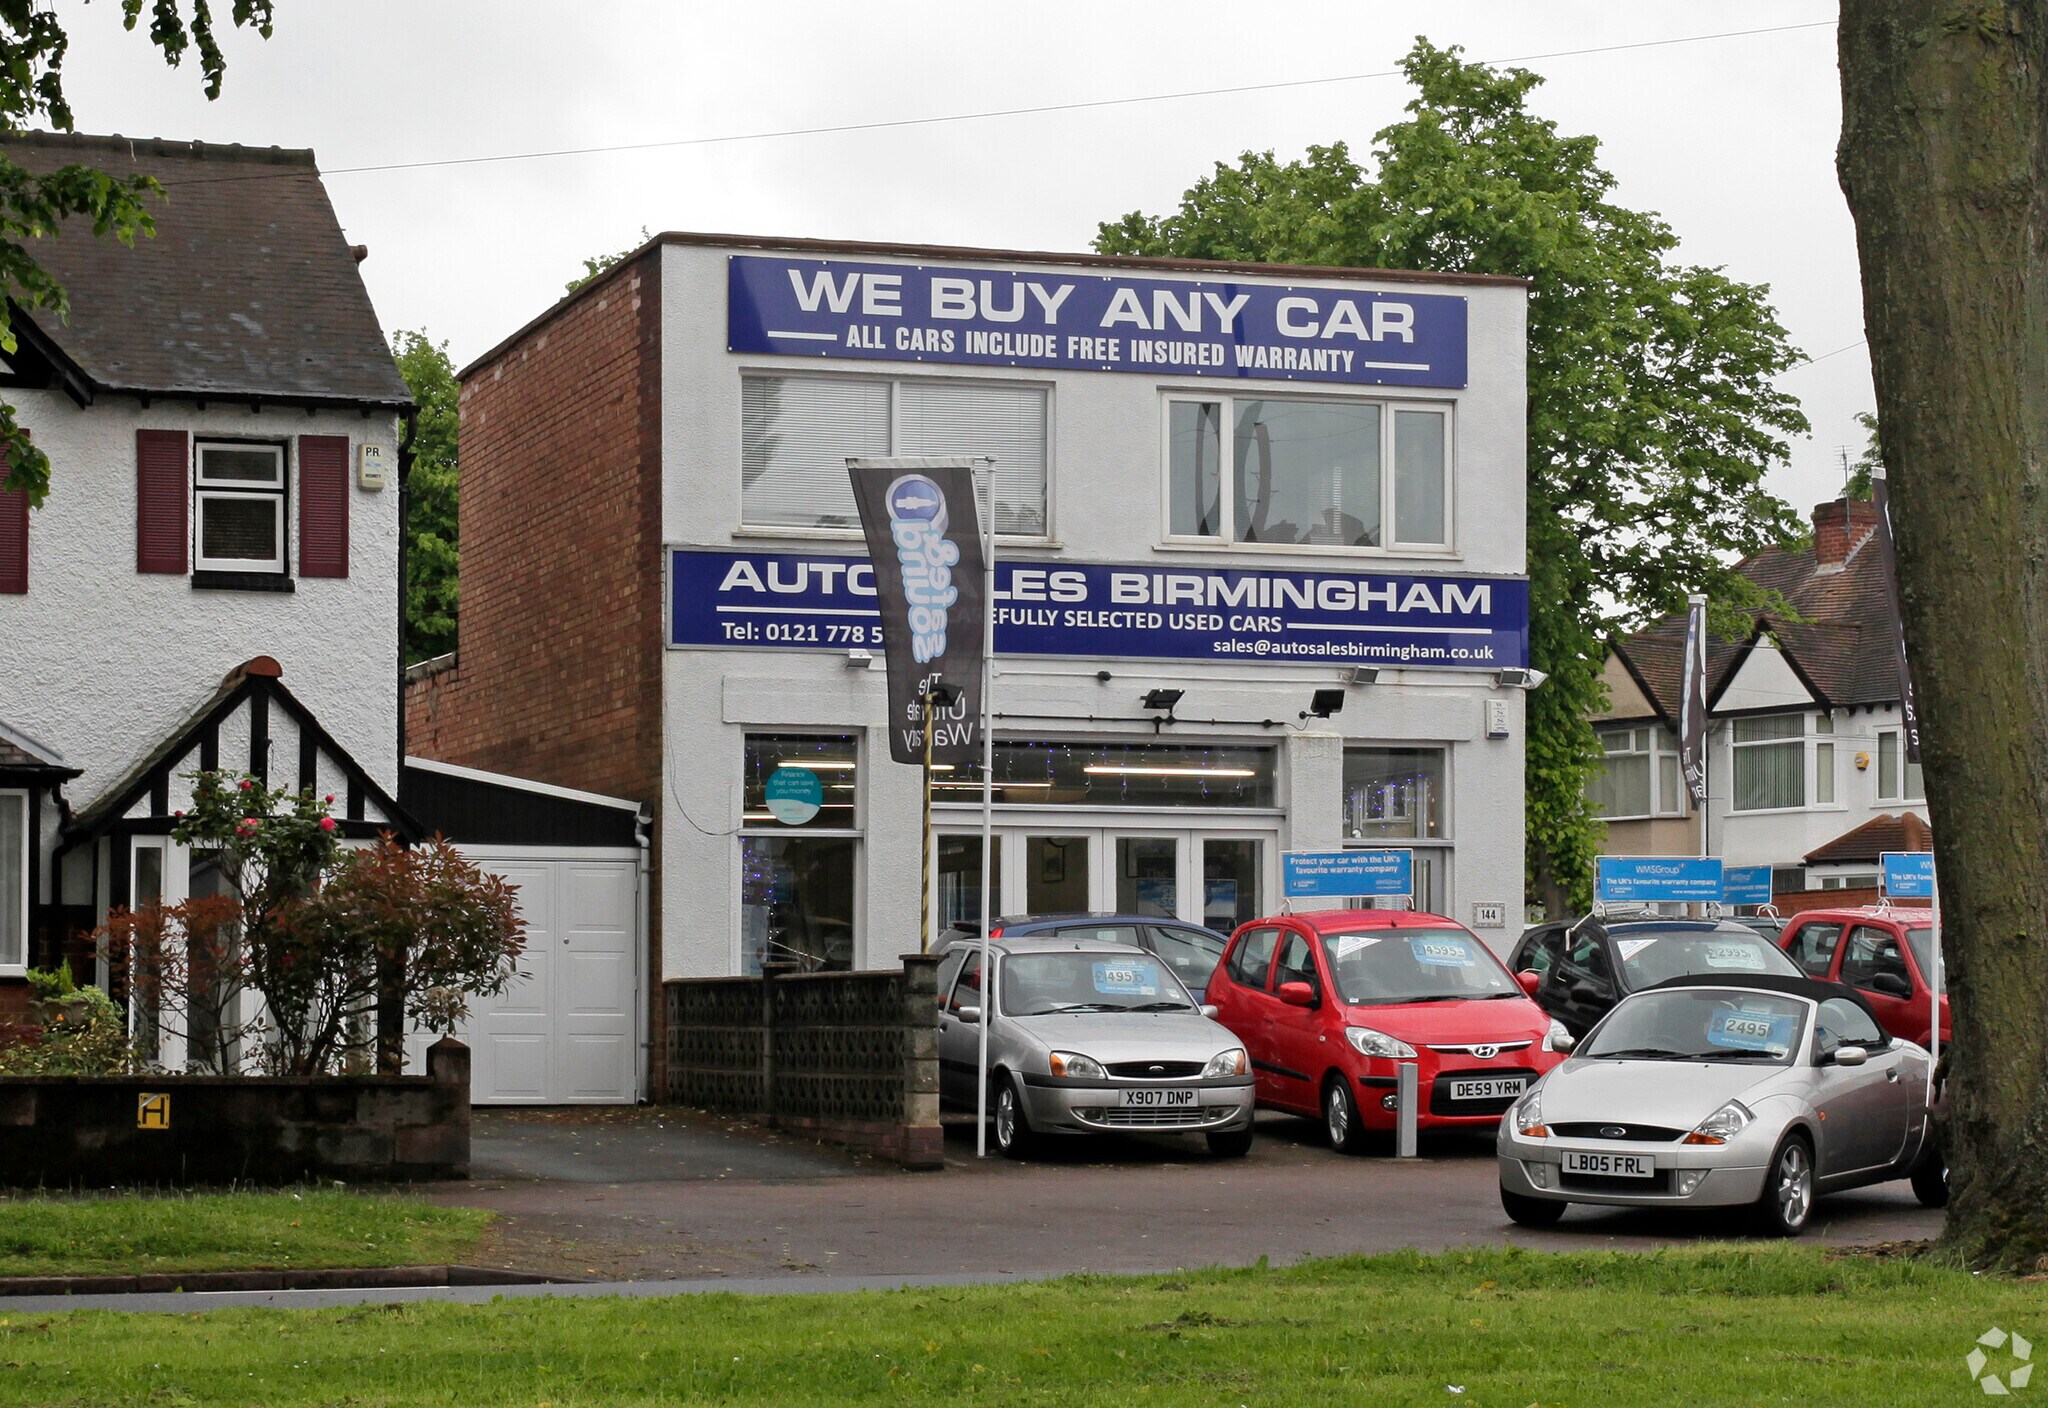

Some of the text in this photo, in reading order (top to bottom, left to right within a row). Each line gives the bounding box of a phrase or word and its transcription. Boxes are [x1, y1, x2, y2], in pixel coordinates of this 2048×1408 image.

[787, 268, 1415, 343] WE BUY ANY CAR
[846, 324, 1355, 373] ALL CARS INCLUDE FREE INSURED WARRANTY
[1111, 572, 1491, 615] BIRMINGHAM
[1064, 608, 1163, 629] SELECTED
[1169, 612, 1223, 631] USED
[1229, 614, 1282, 633] CARS
[721, 622, 759, 641] Tel:
[766, 623, 817, 643] 0121
[827, 624, 864, 644] 778
[1213, 638, 1494, 660] sales@autosalesbirmingham.co.uk
[1290, 857, 1317, 865] Protect
[1319, 857, 1335, 866] your
[1351, 856, 1368, 864] with
[1370, 855, 1382, 863] the
[1383, 855, 1401, 863] UK's
[1296, 865, 1398, 875] favourite warranty company
[1635, 864, 1680, 875] WMSGroup
[1690, 879, 1717, 887] company
[1481, 909, 1496, 920] 144
[1126, 1091, 1193, 1105] X907 DNP
[1457, 1080, 1521, 1097] DE59 YRM
[142, 1097, 165, 1125] H
[1568, 1155, 1646, 1174] LB05 FRL
